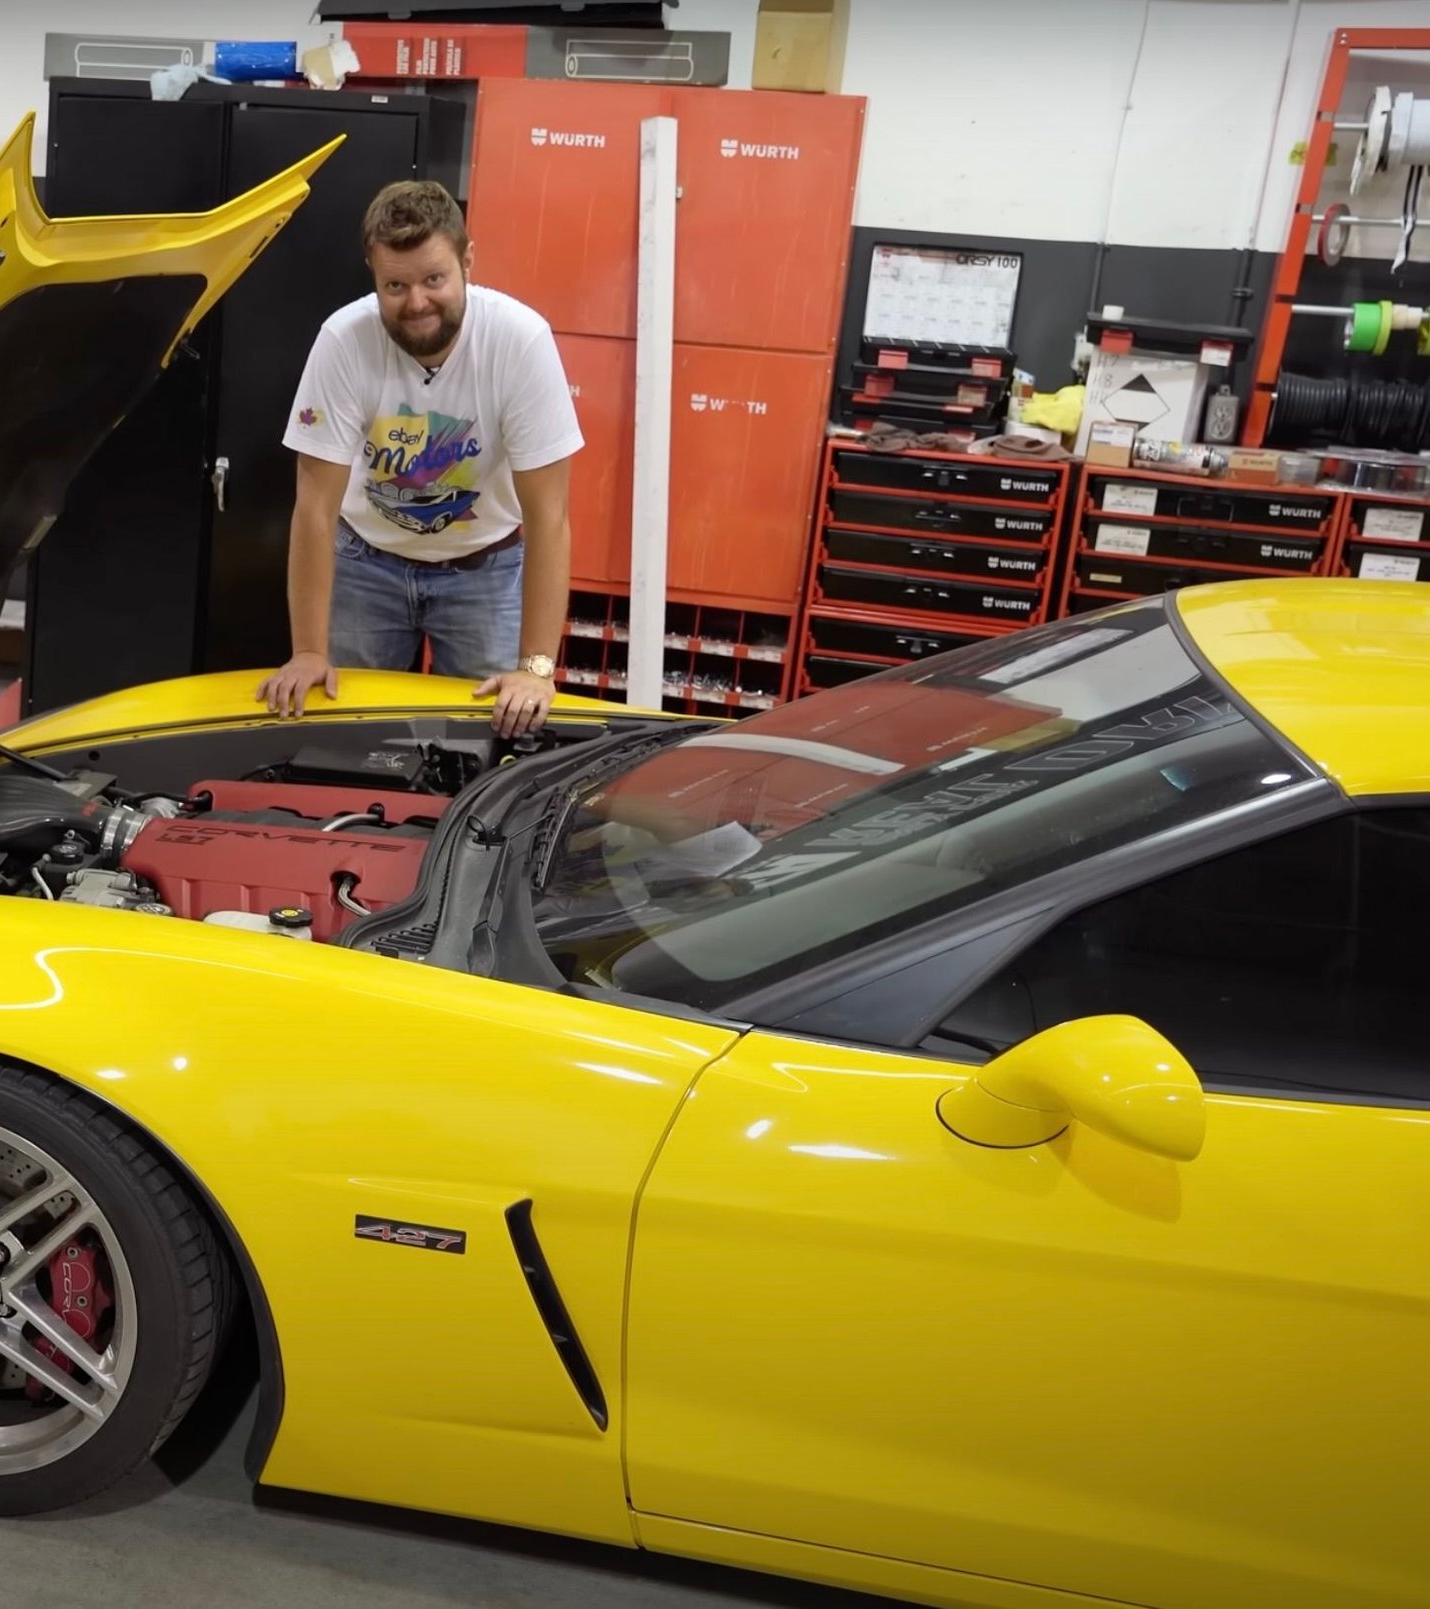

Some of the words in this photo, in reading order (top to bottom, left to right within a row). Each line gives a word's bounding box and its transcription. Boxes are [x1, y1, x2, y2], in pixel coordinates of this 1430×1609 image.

[549, 132, 606, 148] WURTH
[740, 143, 800, 160] WURTH
[710, 398, 768, 416] WTH
[388, 427, 424, 445] ebay
[363, 435, 482, 476] Motors
[1012, 481, 1050, 492] WURTH
[1281, 506, 1322, 519] WURTH
[1006, 519, 1044, 531] WURTH
[1273, 547, 1313, 560] WURTH
[999, 559, 1037, 571] WURTH
[994, 599, 1031, 611] WURTH
[165, 825, 407, 852] CORVETTE
[355, 1223, 463, 1249] 427
